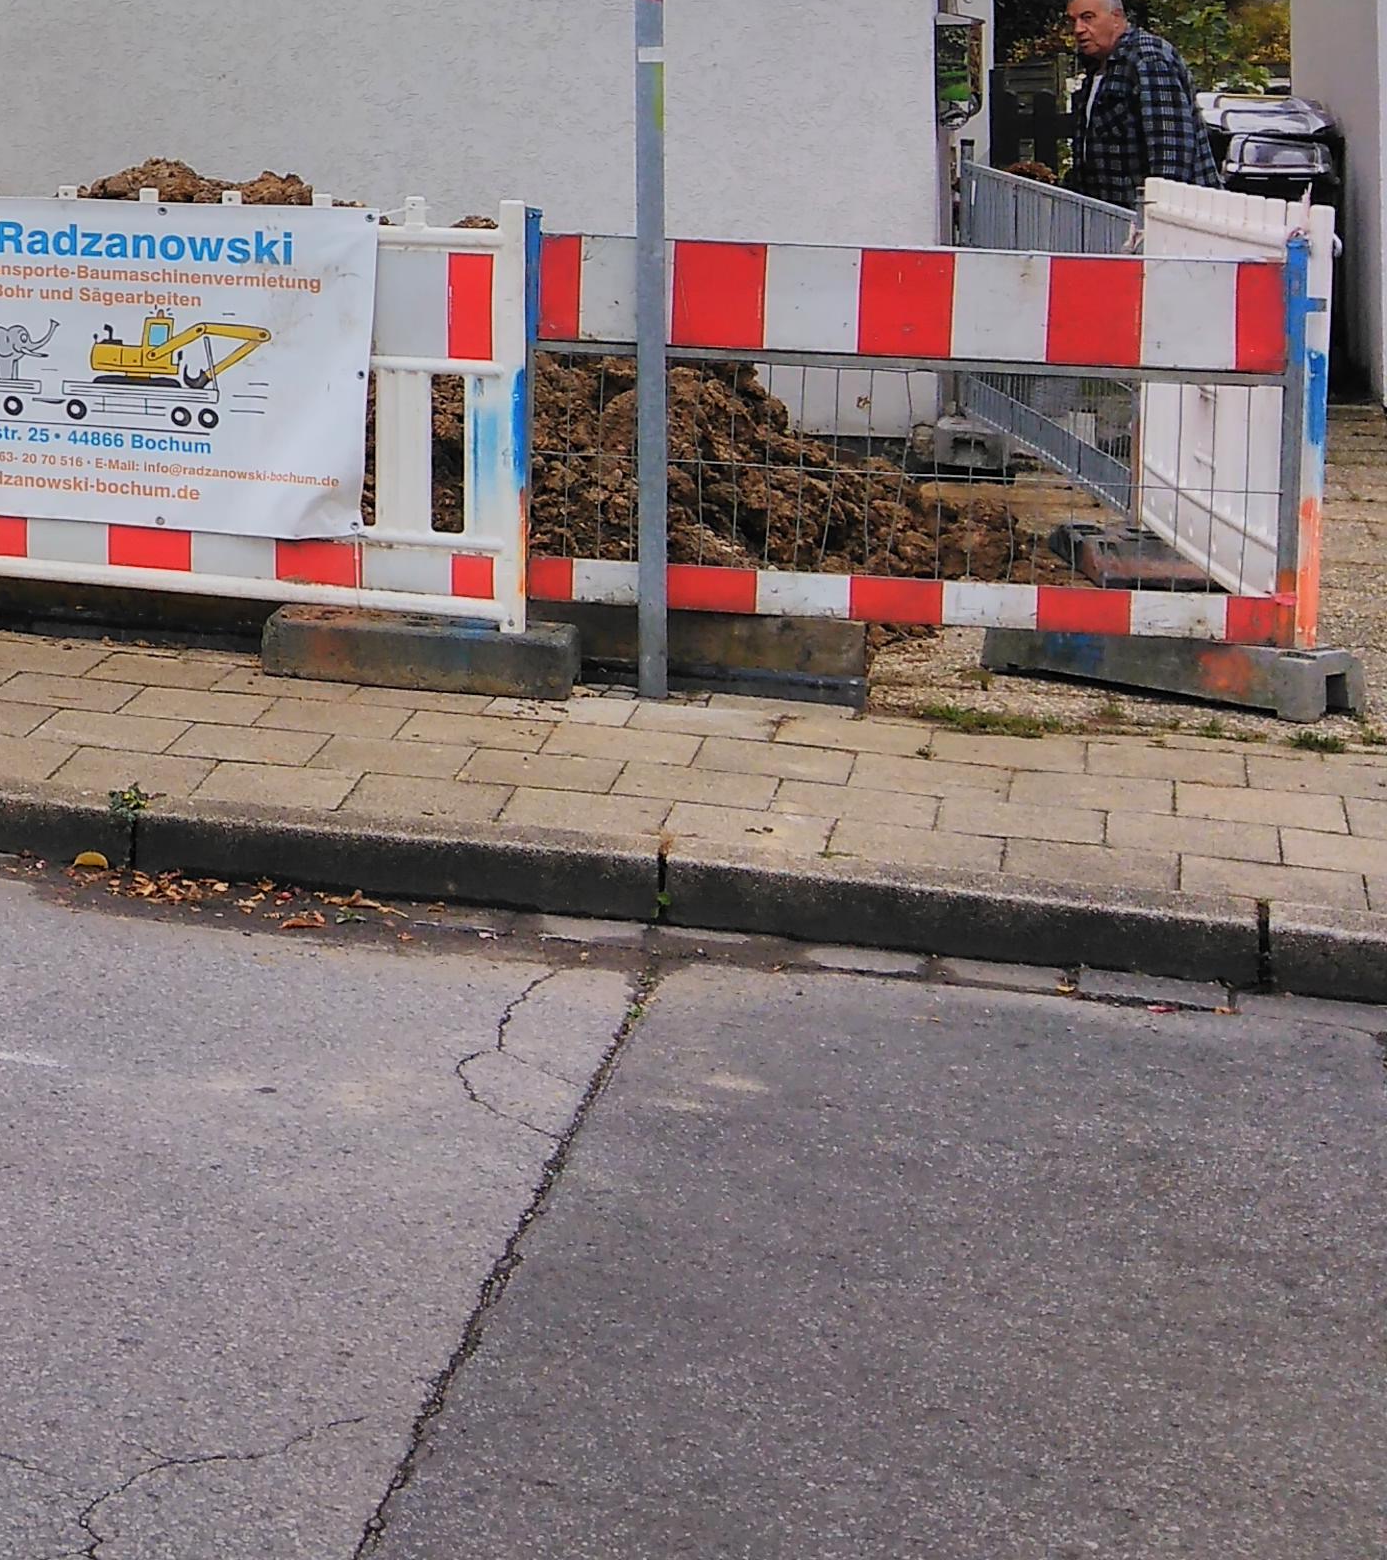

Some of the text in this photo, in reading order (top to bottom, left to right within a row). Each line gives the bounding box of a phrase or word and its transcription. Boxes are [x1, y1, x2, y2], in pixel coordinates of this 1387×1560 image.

[39, 286, 73, 301] und
[79, 287, 202, 307] Sägearbeiten
[28, 427, 50, 443] 25
[67, 430, 124, 448] 44866
[131, 434, 212, 454] Bochum
[22, 453, 37, 464] 20
[41, 454, 56, 465] 70
[60, 455, 84, 467] 516
[95, 458, 139, 472] E-Mail:
